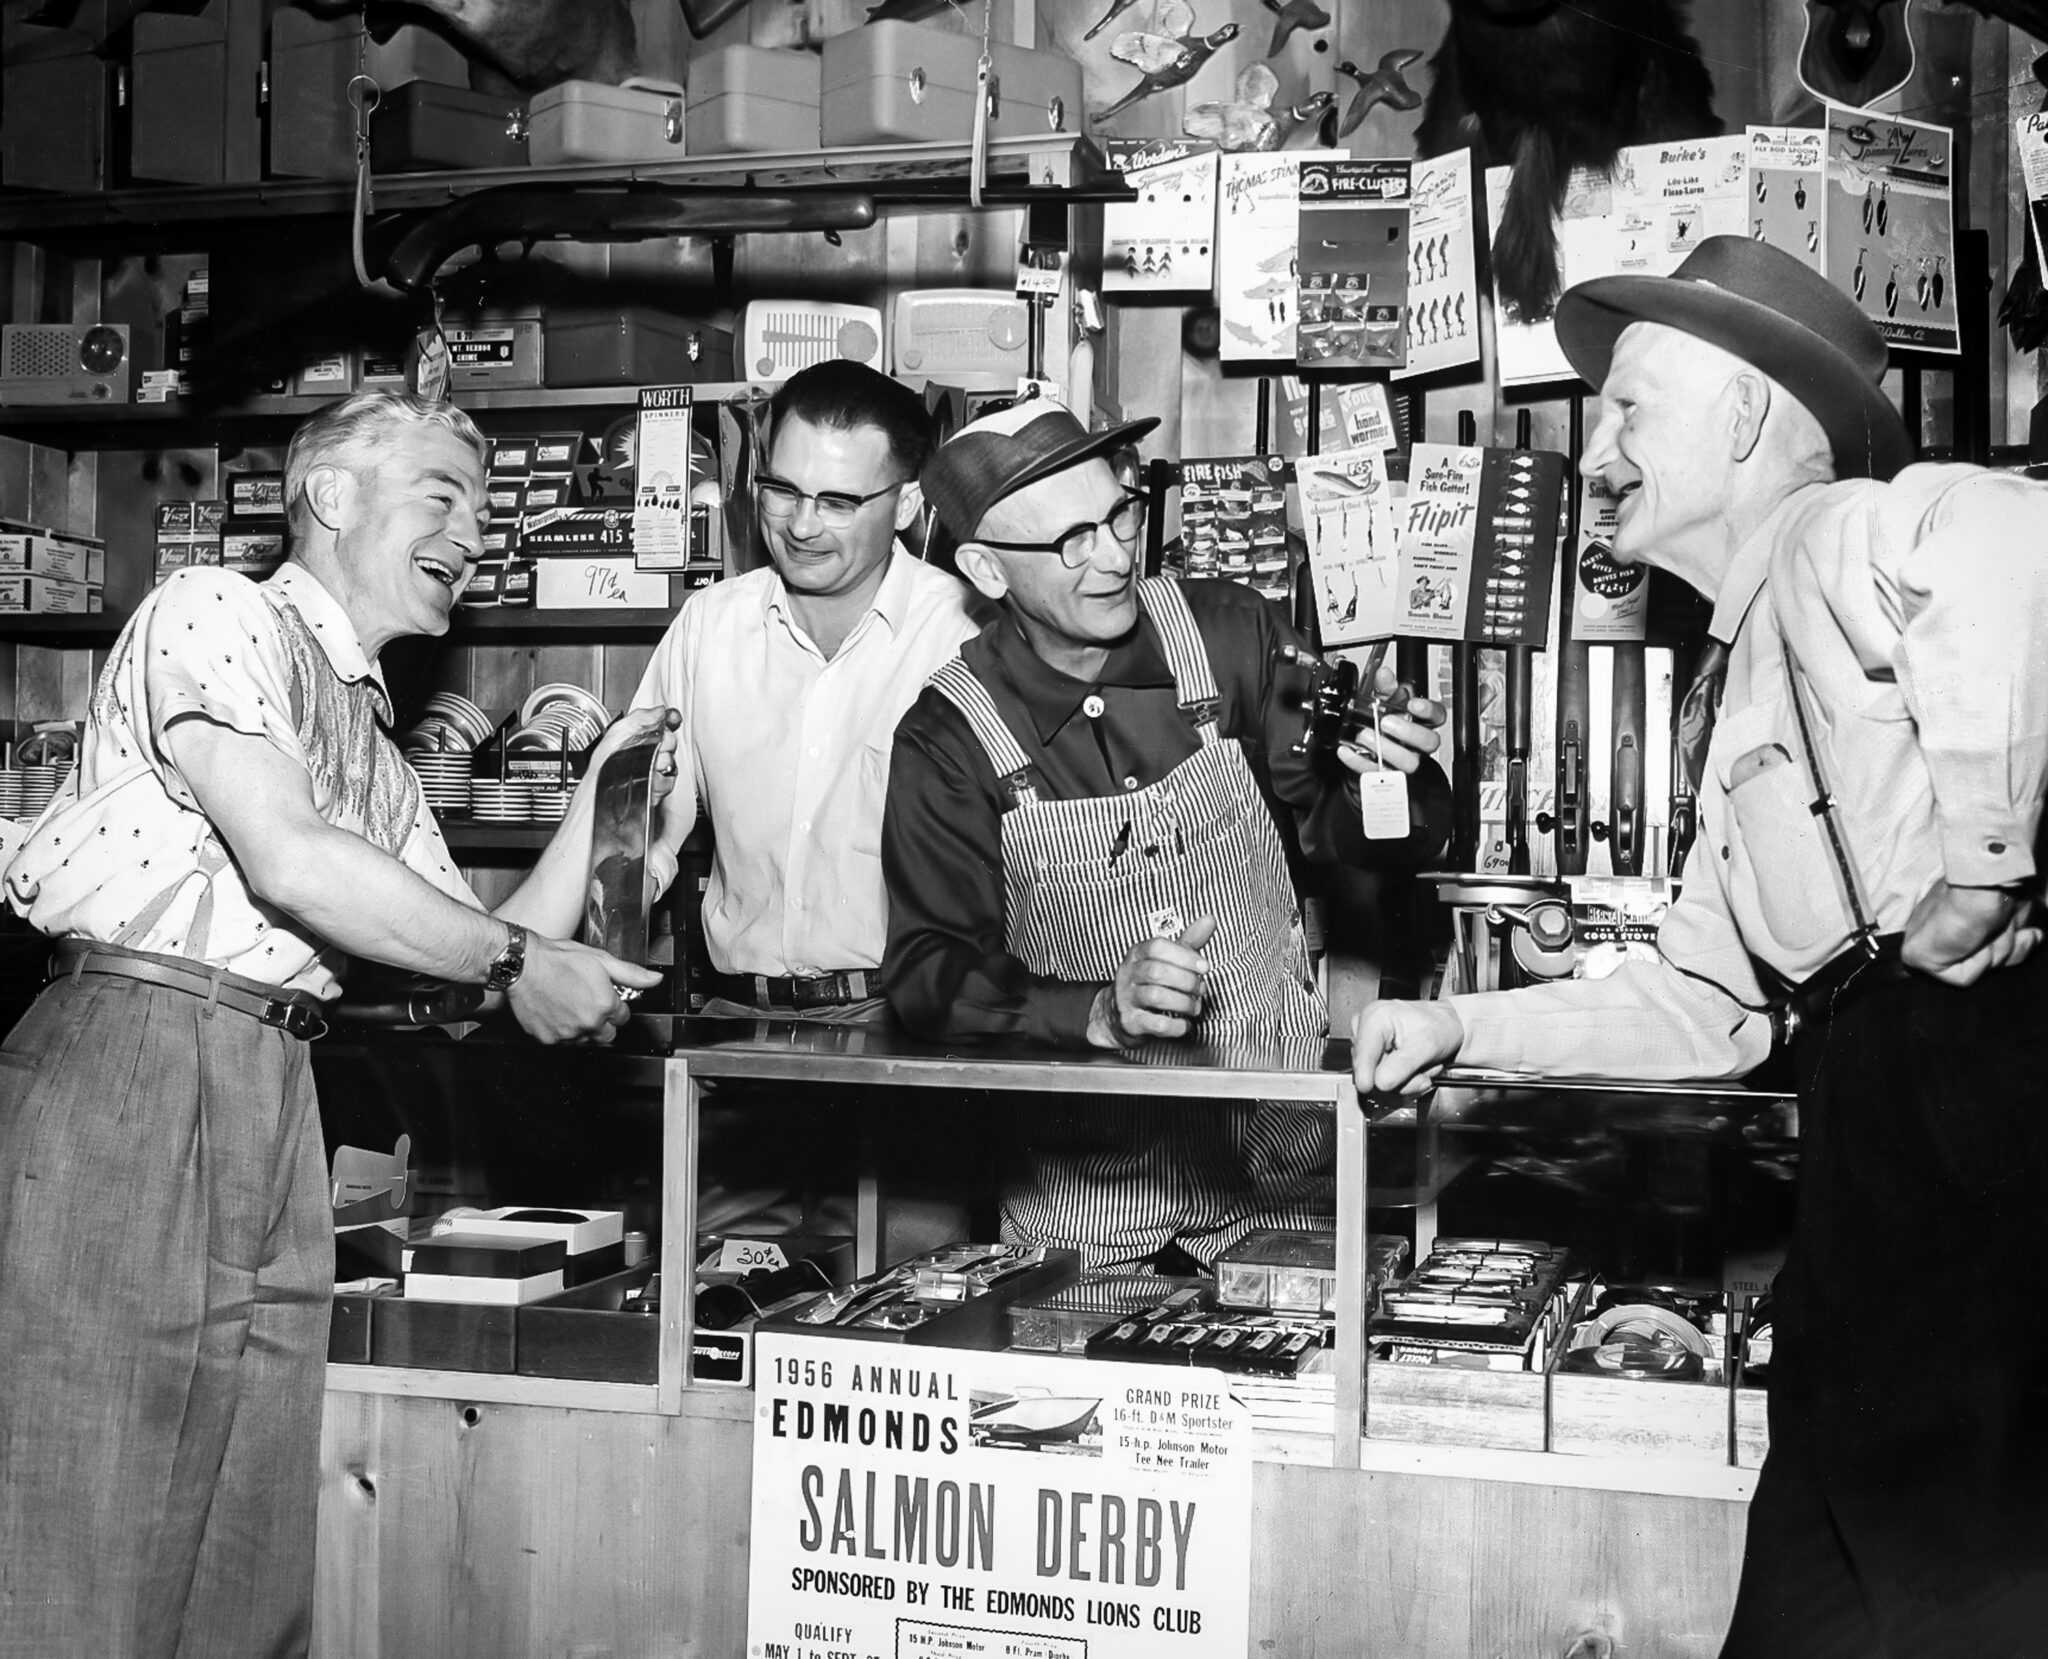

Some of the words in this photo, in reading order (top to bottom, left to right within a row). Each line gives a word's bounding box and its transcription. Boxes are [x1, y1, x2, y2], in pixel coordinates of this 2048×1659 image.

[1131, 143, 1191, 171] Worden's
[1659, 146, 1707, 164] Burke's
[1226, 170, 1267, 199] THOMAS
[642, 388, 690, 408] WORTH
[644, 410, 686, 420] SPINNERS
[1354, 409, 1381, 431] hand
[1350, 425, 1389, 445] warmer
[1441, 457, 1449, 469] A
[1183, 464, 1214, 483] FIRE
[1213, 463, 1243, 488] FISH
[1424, 467, 1464, 481] Sure-Fire
[1420, 480, 1438, 492] Fish
[1439, 481, 1470, 496] Getter!
[526, 509, 558, 529] Waterproof
[1407, 501, 1476, 537] Flipit
[529, 532, 596, 543] SEAMLESS
[600, 529, 623, 544] 415
[1593, 581, 1631, 594] CRAZY!
[1583, 932, 1616, 941] COOK
[1620, 932, 1657, 941] STOVE
[1732, 1281, 1758, 1291] STEEL
[774, 1356, 833, 1389] 1956
[851, 1364, 959, 1401] ANNUAL
[1126, 1388, 1172, 1407] GRAND
[1181, 1392, 1221, 1410] PRIZE
[772, 1398, 959, 1455] EDMONDS
[1181, 1412, 1233, 1430] Sportster
[1158, 1438, 1196, 1454] Johnson
[1200, 1442, 1229, 1456] Motor
[1136, 1452, 1152, 1465] Tee
[1156, 1454, 1175, 1467] Nee
[1180, 1456, 1210, 1470] Trailer
[800, 1464, 996, 1572] SALMON
[1036, 1488, 1197, 1591] DERBY
[791, 1566, 896, 1601] SPONSORED
[906, 1580, 930, 1606] BY
[940, 1585, 976, 1612] THE
[986, 1589, 1076, 1622] EDMONDS
[1086, 1599, 1141, 1629] LIONS
[1152, 1606, 1202, 1635] CLUB
[794, 1622, 853, 1645] QUALIFY
[764, 1643, 791, 1659] MAY
[938, 1637, 964, 1650] Johnson
[966, 1640, 985, 1652] Motor
